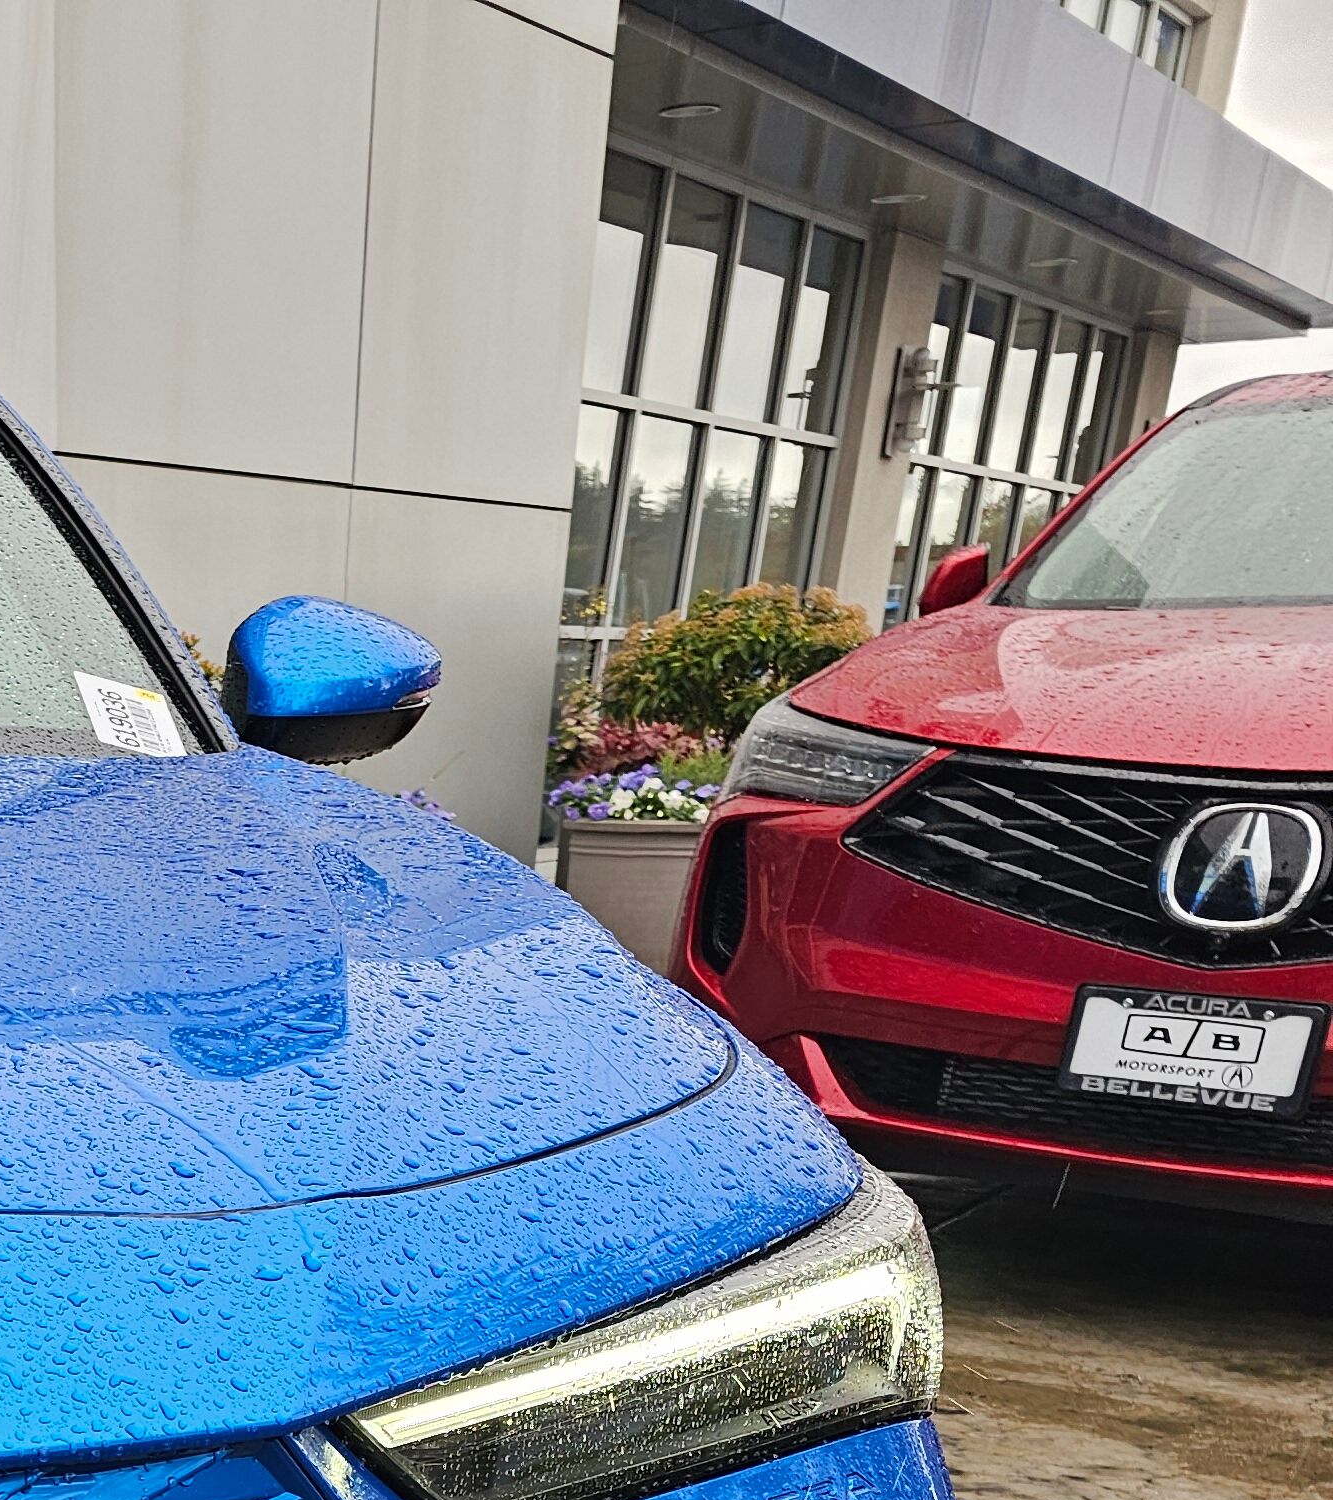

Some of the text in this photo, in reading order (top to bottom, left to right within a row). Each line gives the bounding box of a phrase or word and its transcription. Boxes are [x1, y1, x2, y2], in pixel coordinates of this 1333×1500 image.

[98, 688, 140, 747] 619036
[1143, 994, 1251, 1018] ACURA
[1143, 1026, 1241, 1052] A B
[1115, 1059, 1216, 1080] MOTORSPORT
[1081, 1077, 1276, 1112] BELLEVUE
